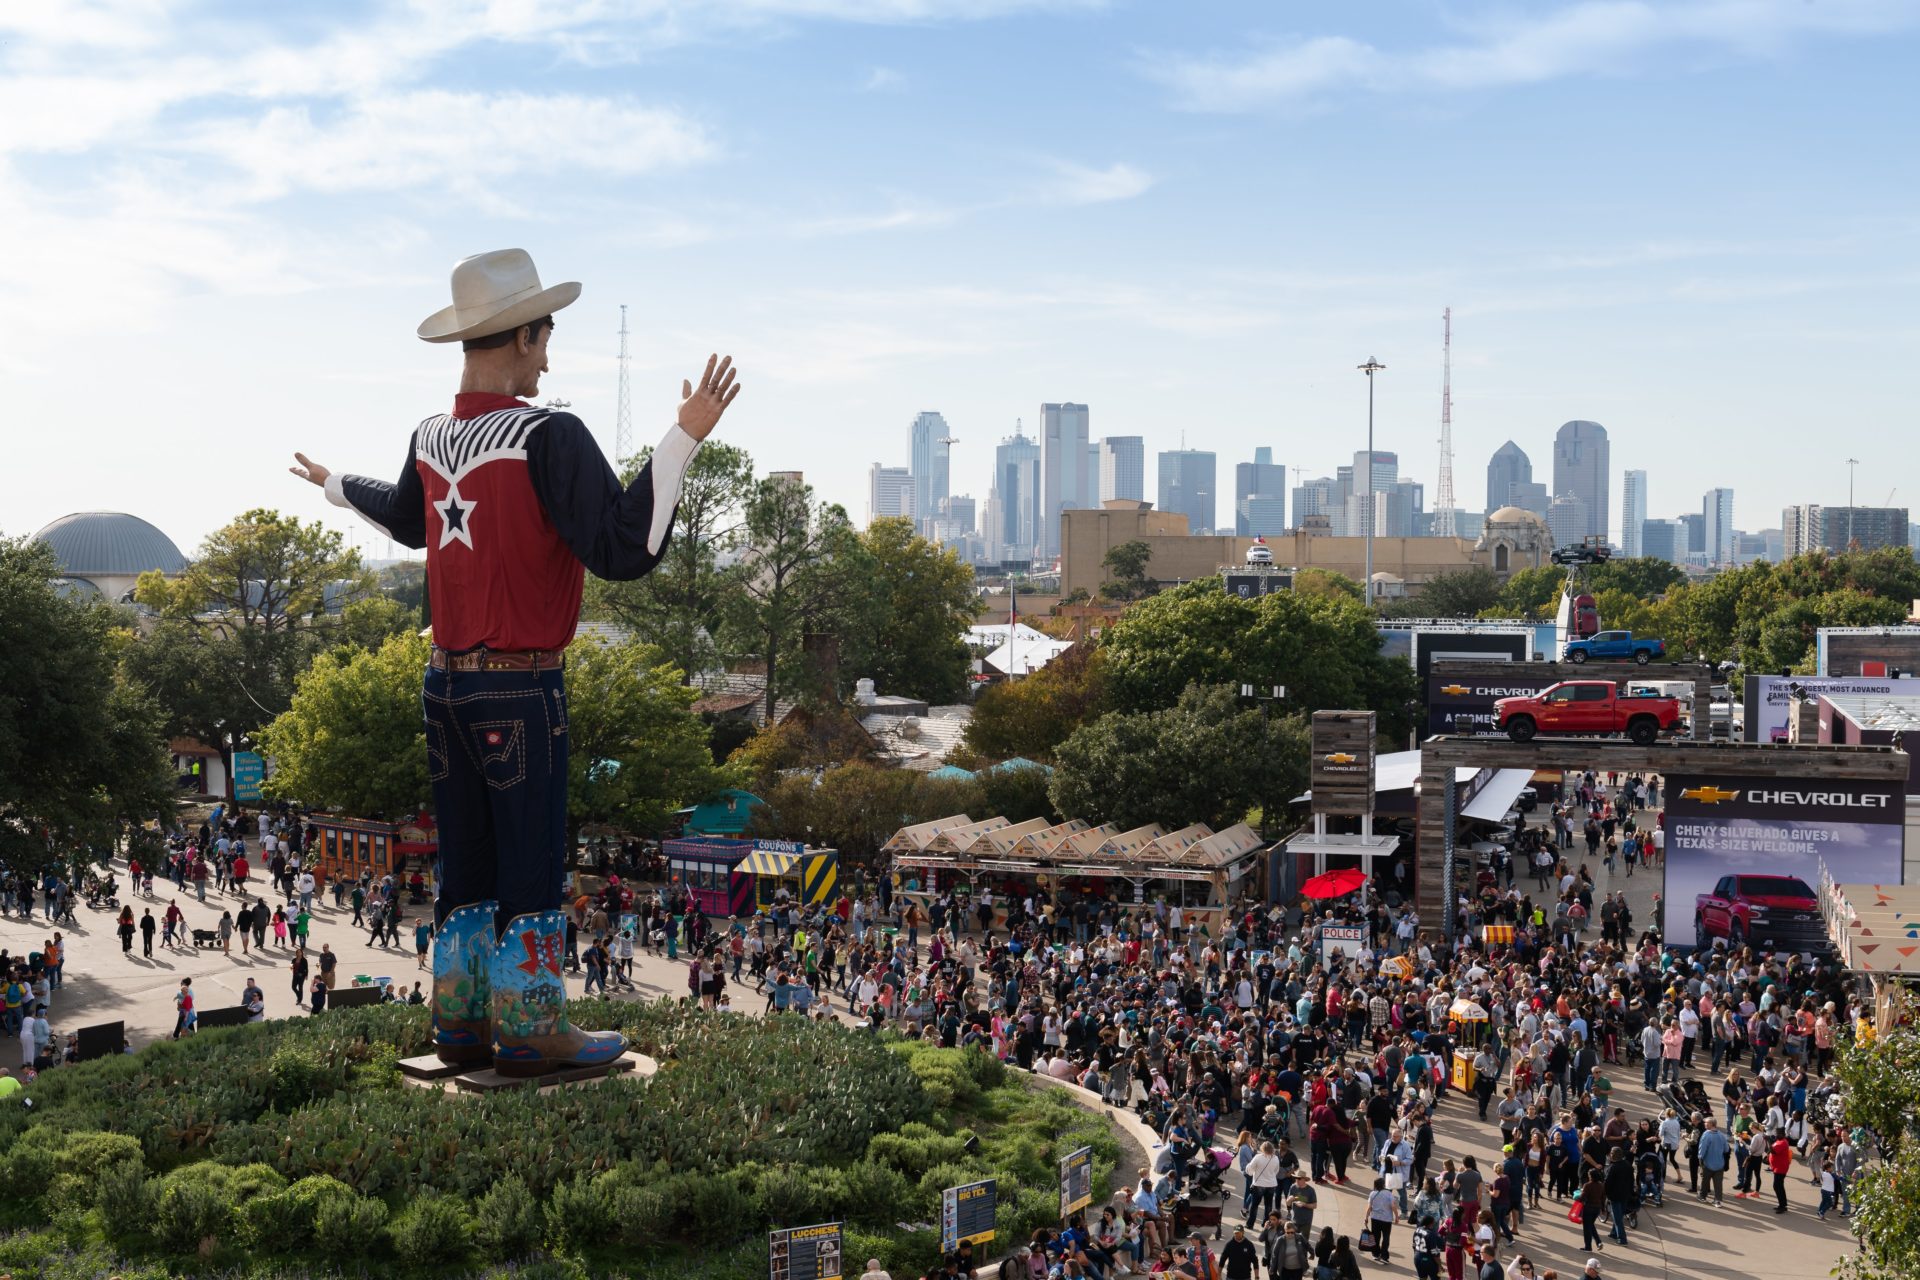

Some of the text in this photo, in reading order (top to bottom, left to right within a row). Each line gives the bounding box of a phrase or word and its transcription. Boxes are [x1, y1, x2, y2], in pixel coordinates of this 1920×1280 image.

[1475, 687, 1545, 696] CHEVROL
[1768, 684, 1783, 692] THE
[1830, 685, 1850, 693] MOST
[1851, 686, 1890, 694] ADVANCED
[1445, 713, 1453, 722] A
[1747, 790, 1891, 808] CHEVROLET
[1675, 824, 1840, 842] CHEVY SILVERADO GIVES A
[758, 840, 797, 852] COUPONS
[1675, 837, 1818, 854] TEXAS-SIZE WELCOME.
[1323, 928, 1360, 939] POLICE
[958, 1191, 971, 1201] BIG
[972, 1187, 986, 1198] TEX
[791, 1225, 839, 1239] LUCCHESE
